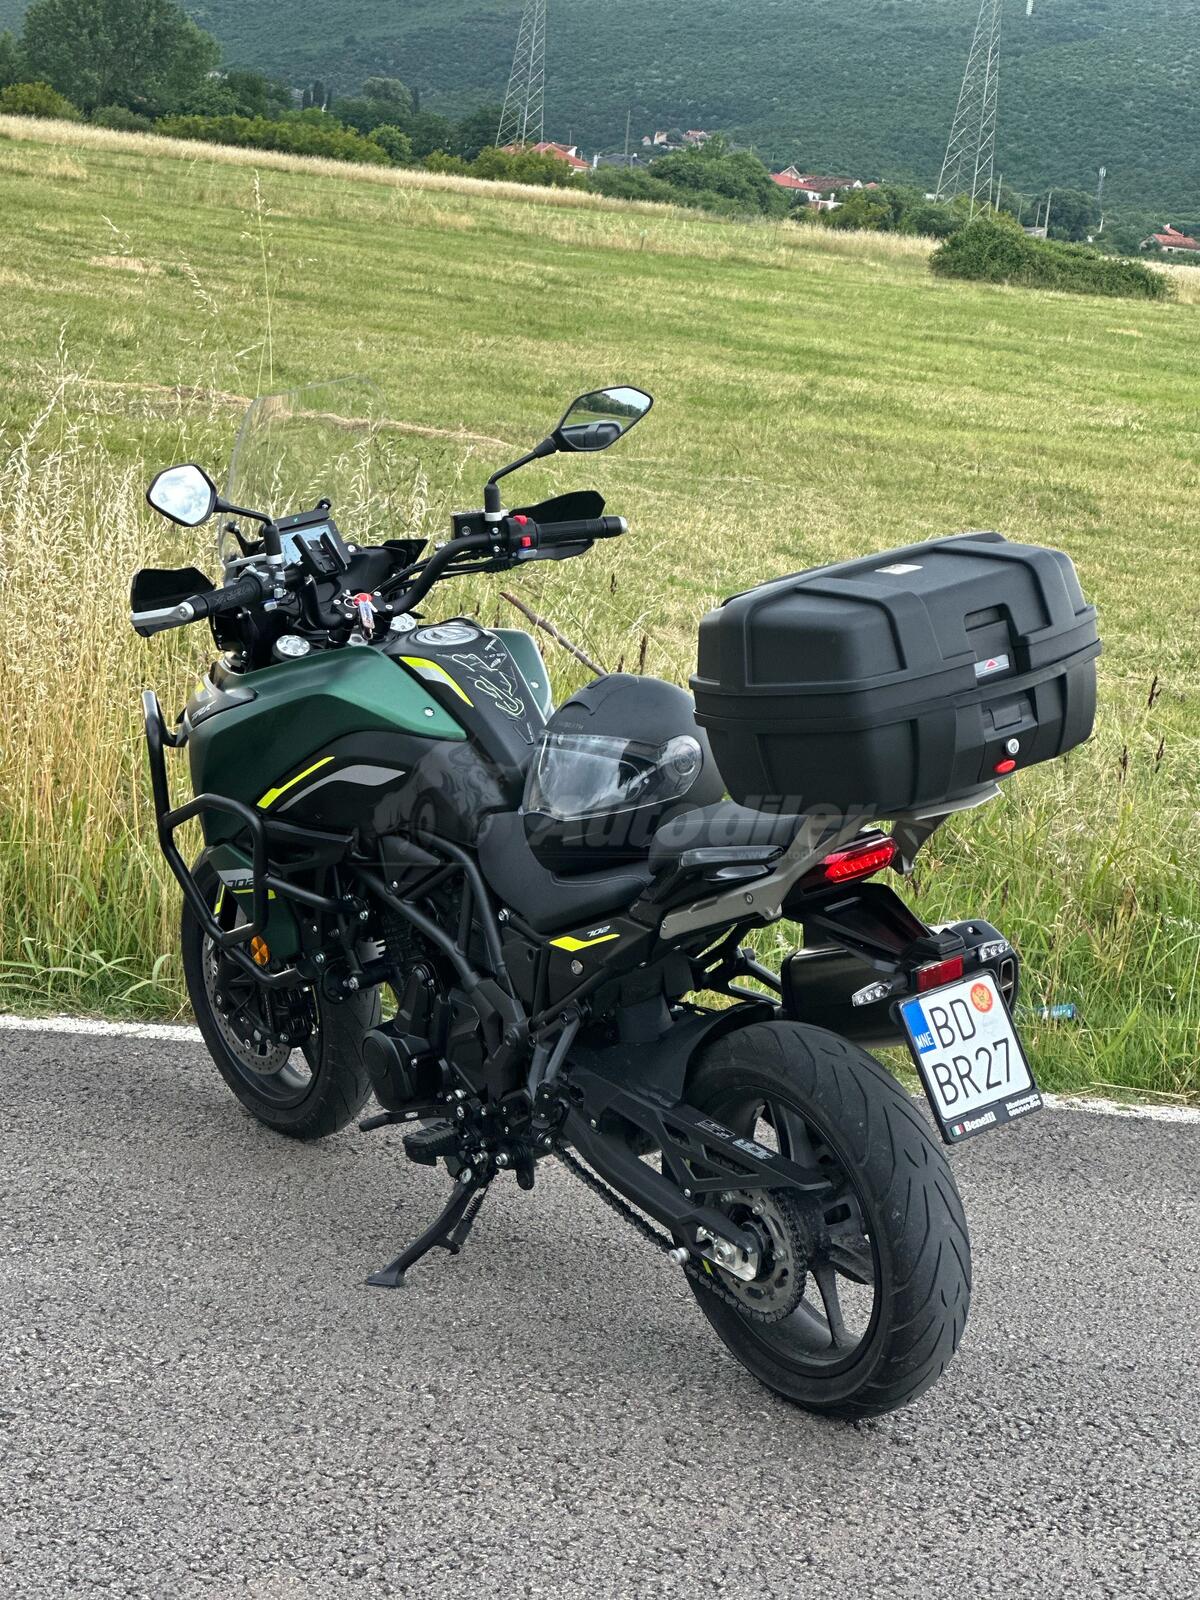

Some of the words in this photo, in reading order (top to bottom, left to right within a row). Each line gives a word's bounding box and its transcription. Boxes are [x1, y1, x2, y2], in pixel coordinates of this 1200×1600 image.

[586, 925, 611, 938] 702
[928, 998, 977, 1049] BD
[915, 1031, 935, 1049] MNE
[931, 1037, 1011, 1106] BR27
[963, 1111, 997, 1132] Benelli
